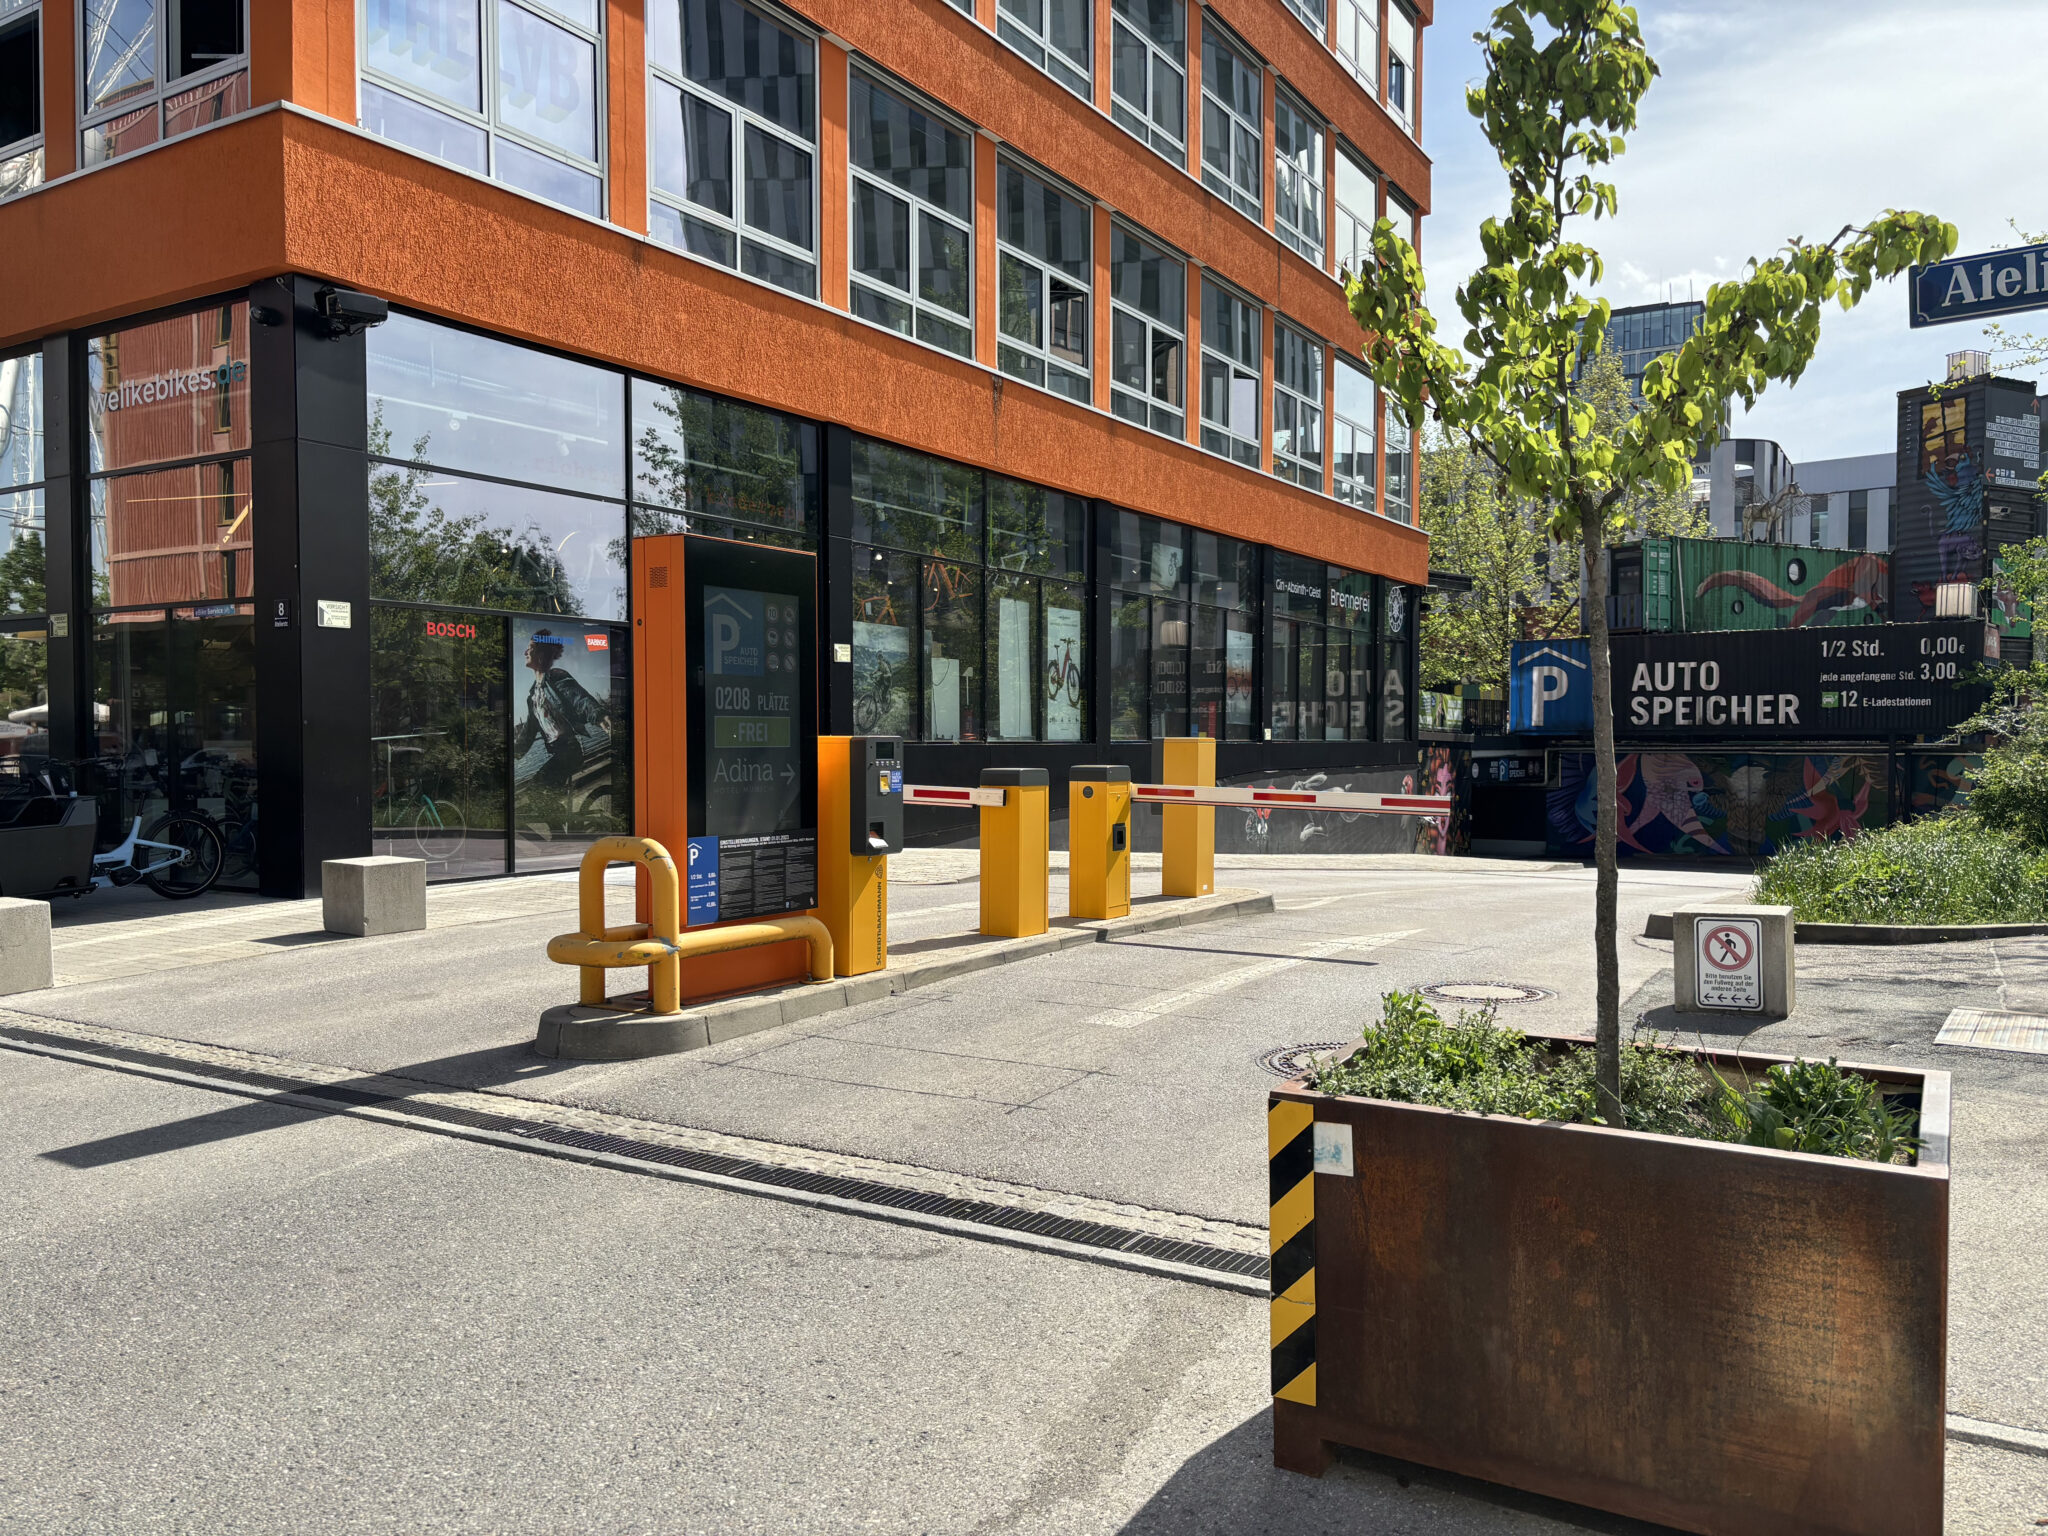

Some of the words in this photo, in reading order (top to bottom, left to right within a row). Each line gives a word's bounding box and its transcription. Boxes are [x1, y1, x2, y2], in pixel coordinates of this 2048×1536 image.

[89, 355, 246, 415] welikebikes.de
[278, 602, 284, 616] 8
[1330, 588, 1370, 612] Brennerei
[426, 621, 475, 639] BOSCH
[740, 648, 758, 656] AUTO
[1821, 640, 1846, 658] 1/2
[1851, 639, 1885, 657] Std.
[724, 656, 758, 666] SPEICHER
[1631, 661, 1720, 692] AUTO
[1820, 672, 1838, 683] jede
[1840, 671, 1896, 683] angefangene
[1898, 670, 1916, 681] Std.
[715, 686, 750, 711] 0208
[757, 692, 789, 711] PLÄTZE
[1531, 666, 1568, 727] P
[1840, 690, 1858, 707] 12
[1863, 696, 1931, 707] E-Ladestationen
[1630, 693, 1800, 726] SPEICHER
[738, 722, 768, 742] FREI
[713, 757, 774, 783] Adina
